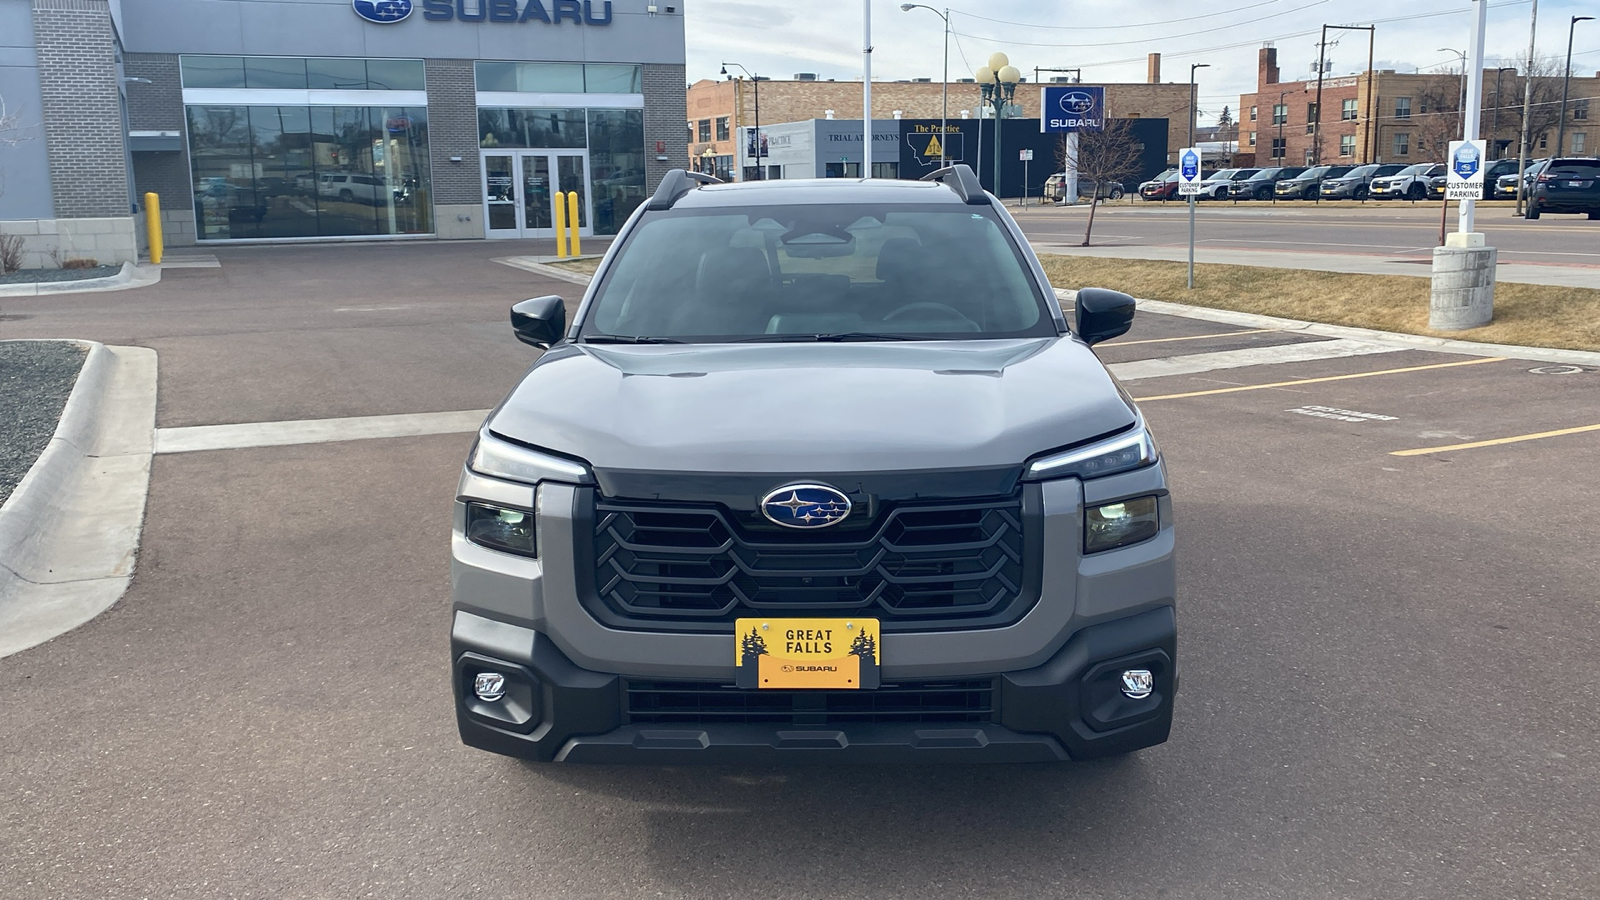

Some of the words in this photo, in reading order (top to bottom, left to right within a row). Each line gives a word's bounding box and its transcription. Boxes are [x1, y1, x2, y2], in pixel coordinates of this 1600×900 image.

[423, 0, 612, 25] SUBARU
[1050, 119, 1100, 128] SUBARU
[914, 124, 929, 132] The
[828, 134, 853, 142] TRIAL
[1446, 182, 1484, 190] CUSTOMER
[1449, 190, 1480, 198] PARKING
[785, 629, 833, 641] GREAT
[786, 641, 833, 654] FALLS
